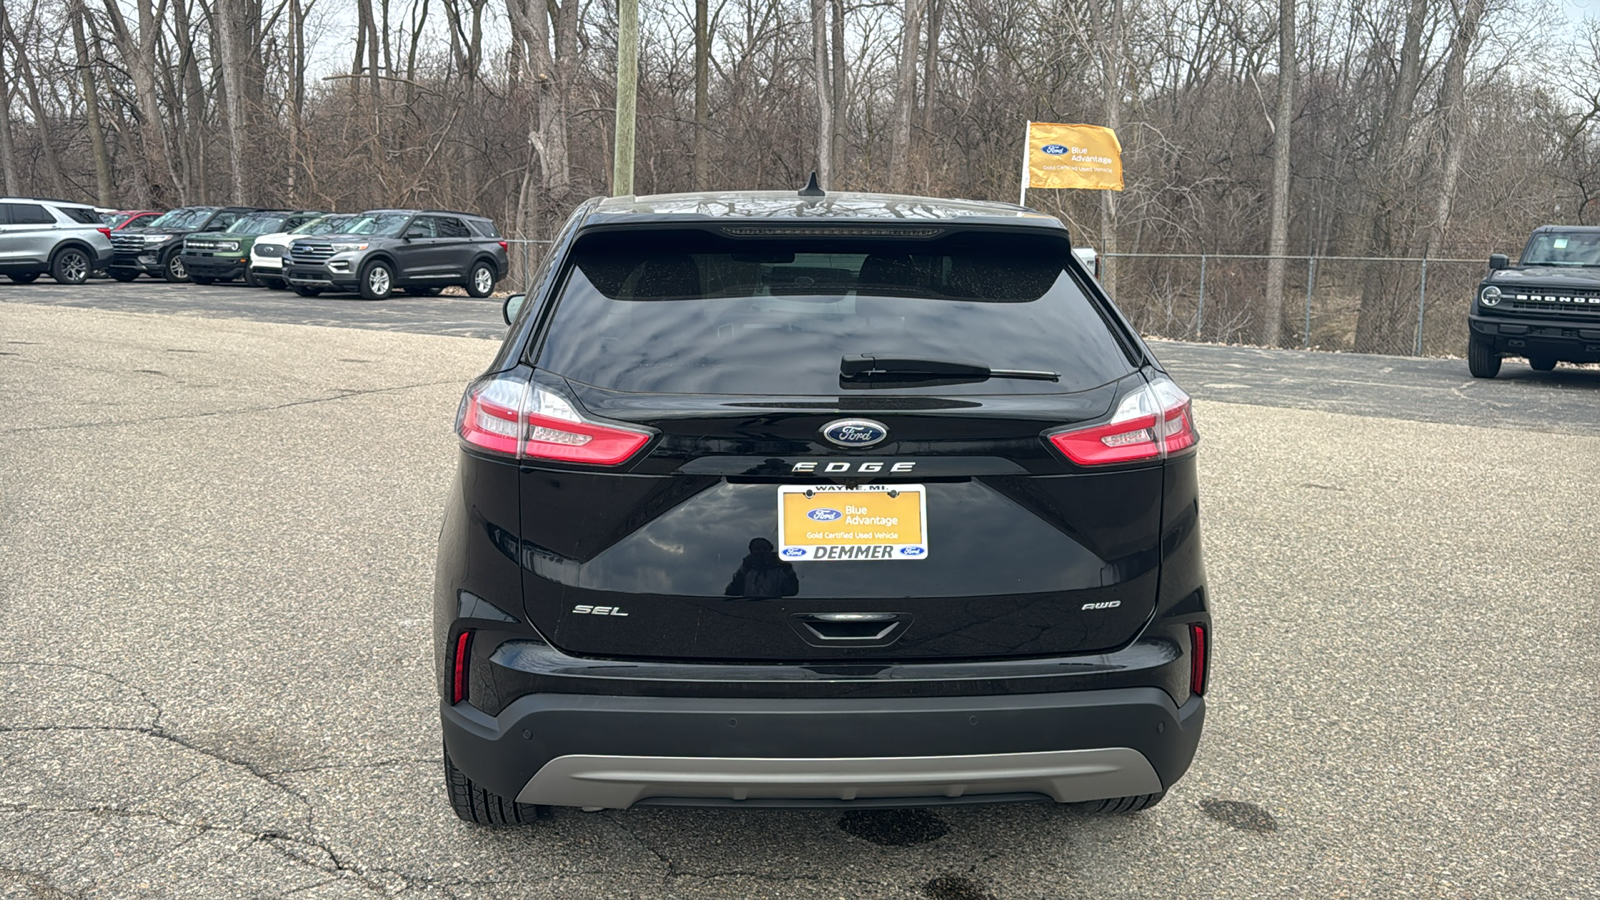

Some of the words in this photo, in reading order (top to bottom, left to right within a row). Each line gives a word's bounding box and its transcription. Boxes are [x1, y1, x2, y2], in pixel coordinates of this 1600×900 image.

[1071, 146, 1088, 154] Blue
[1071, 155, 1112, 164] Advantage
[1516, 294, 1600, 304] BRONCO
[838, 425, 873, 441] Ford
[791, 461, 917, 473] EDGE
[845, 505, 868, 515] Blue
[845, 515, 899, 527] Advantage
[806, 531, 823, 539] Gold
[824, 531, 854, 539] Certified
[854, 531, 872, 539] Used
[874, 531, 899, 539] Vehicle
[813, 545, 894, 560] DEMMER
[572, 604, 630, 617] SEL
[1081, 600, 1122, 611] AWD
